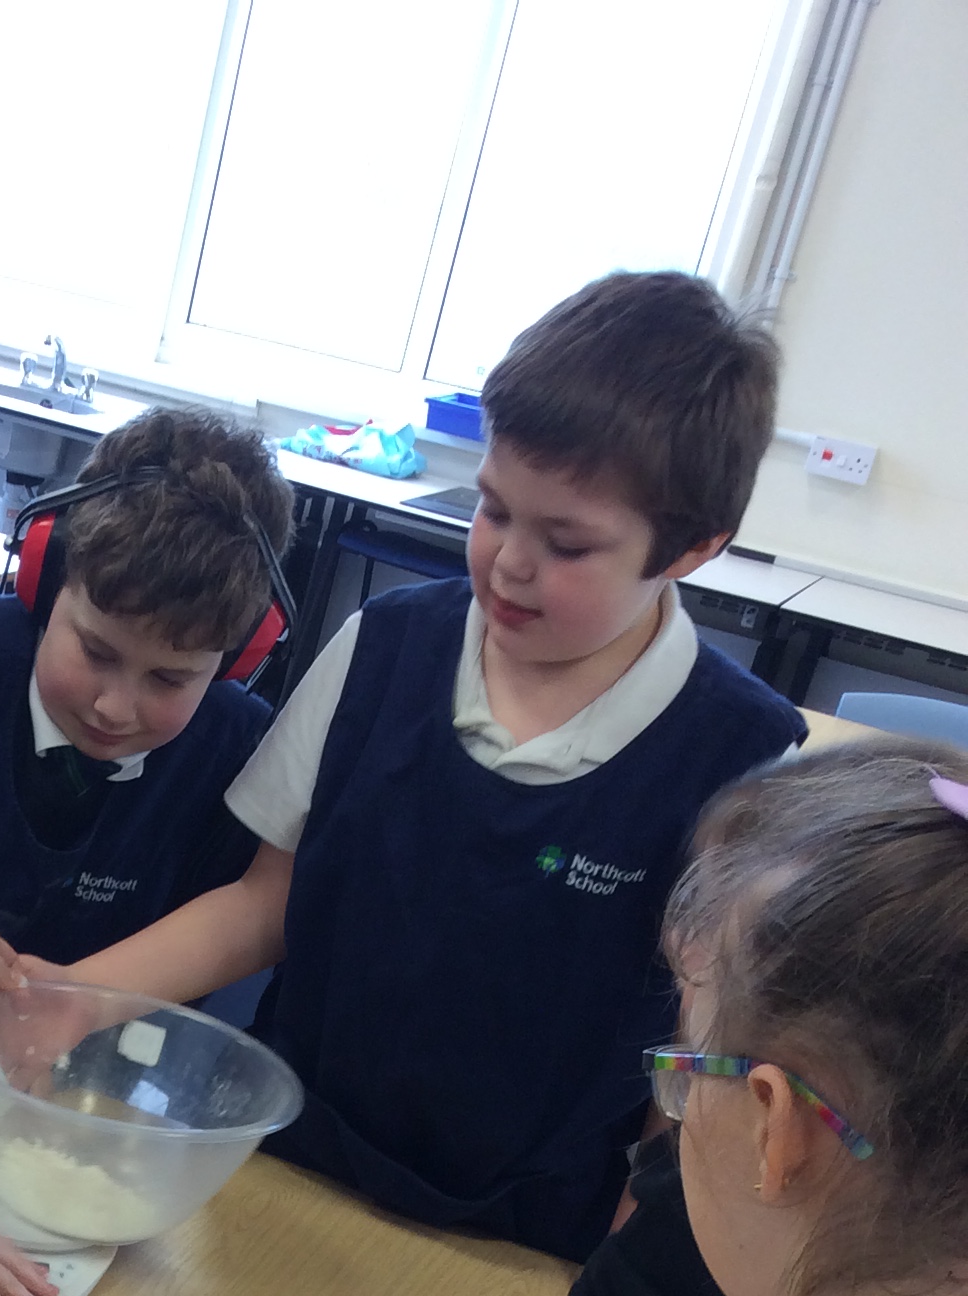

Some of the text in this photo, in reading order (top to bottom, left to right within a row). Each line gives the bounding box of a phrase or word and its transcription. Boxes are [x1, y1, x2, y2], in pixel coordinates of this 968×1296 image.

[570, 853, 647, 882] Northcott
[74, 885, 116, 902] School
[565, 870, 618, 895] School
